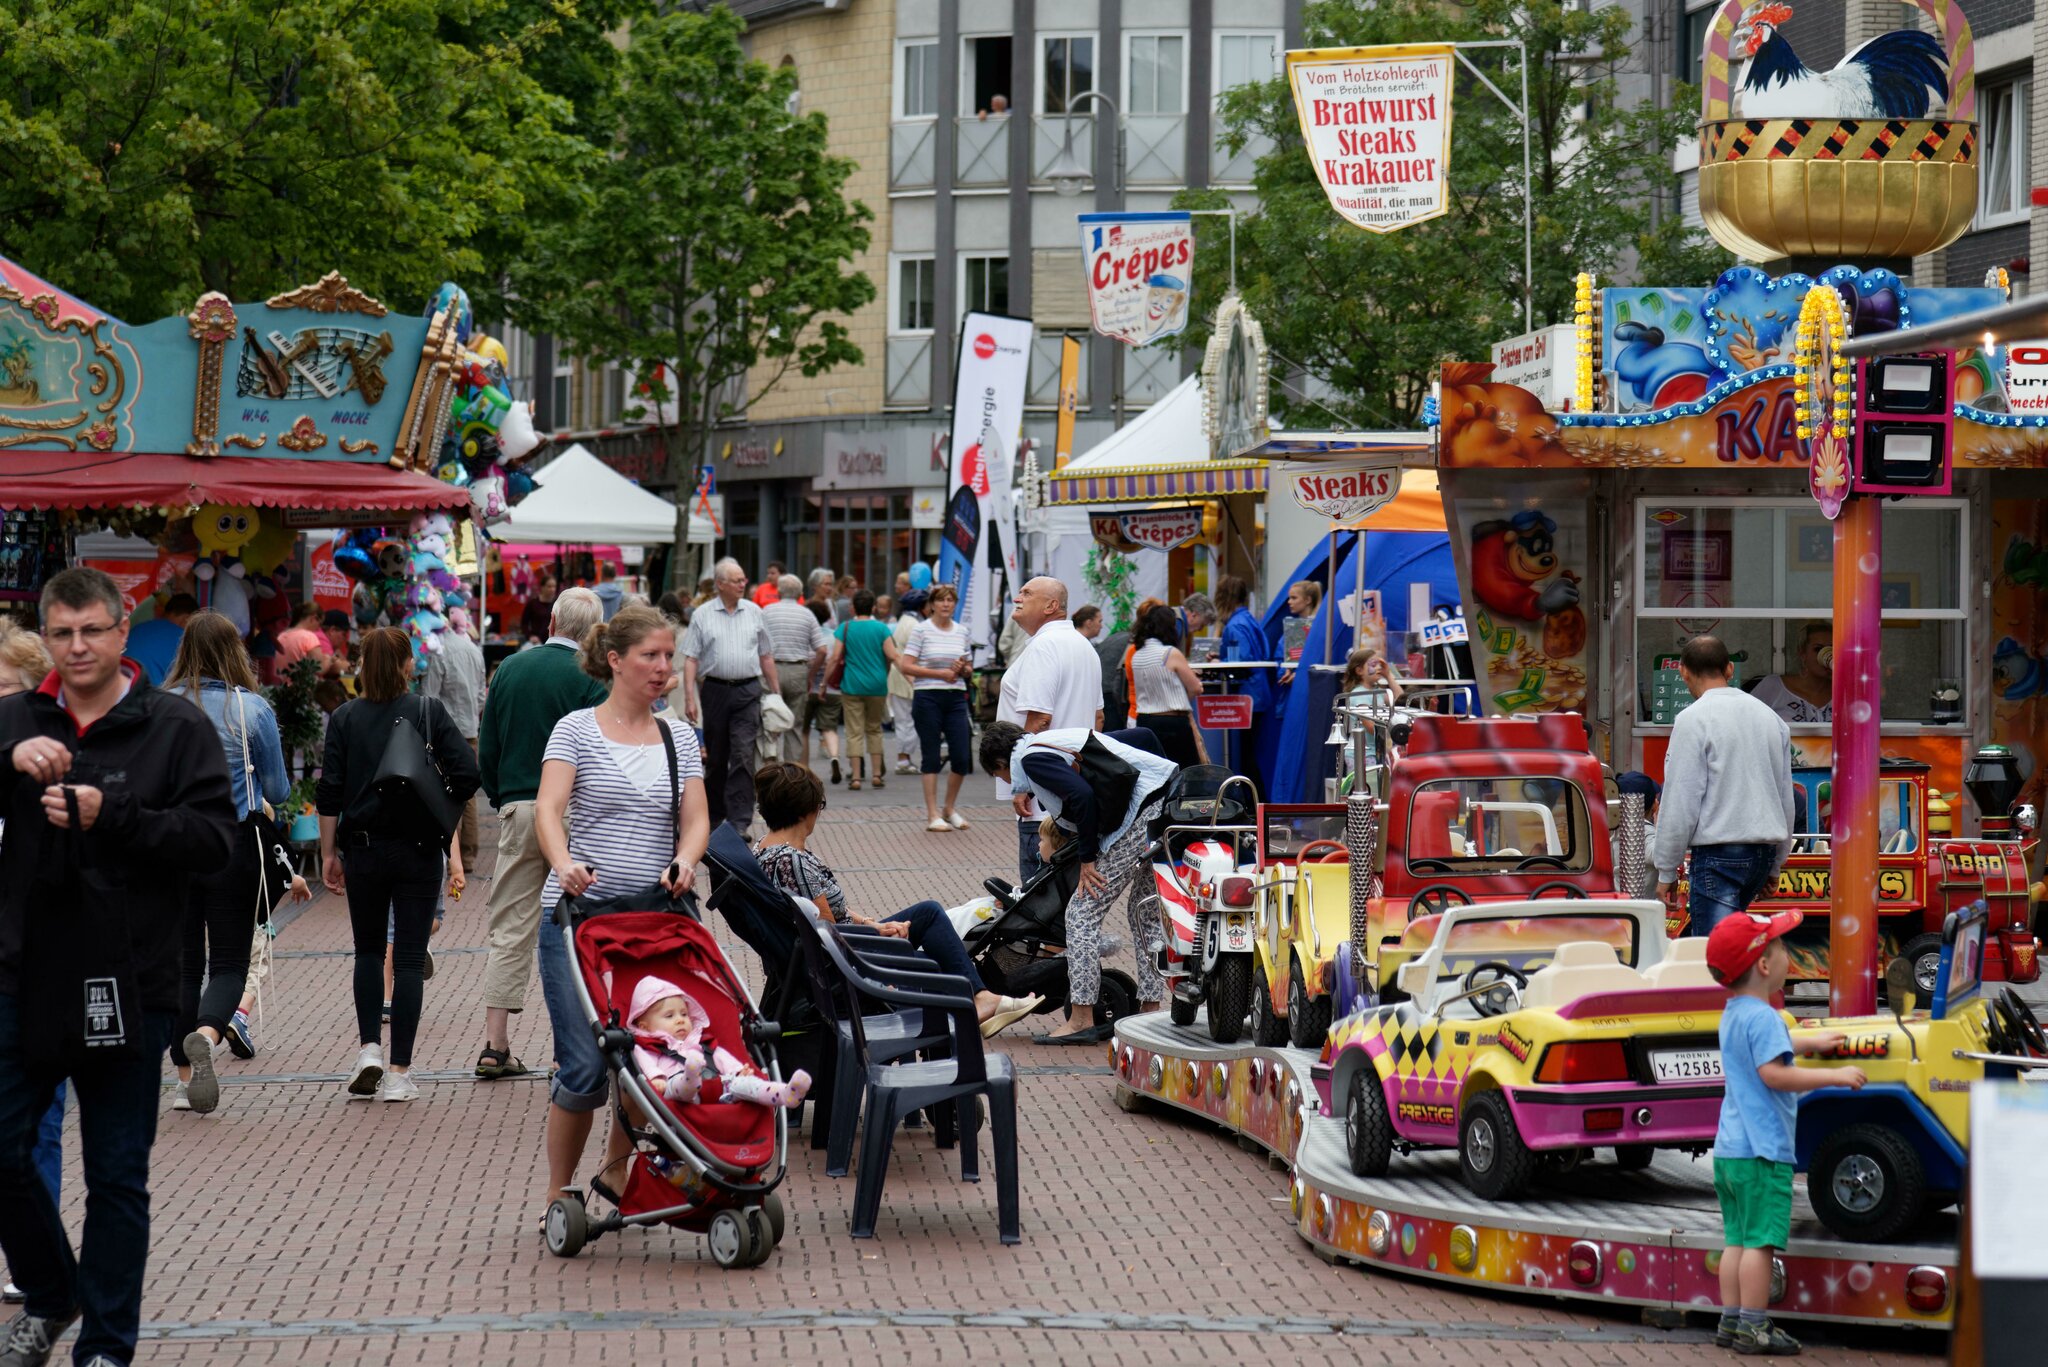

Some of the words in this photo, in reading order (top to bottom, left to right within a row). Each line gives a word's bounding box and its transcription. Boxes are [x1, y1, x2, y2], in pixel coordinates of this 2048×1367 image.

[1307, 71, 1337, 85] Vom
[1343, 63, 1438, 84] Holzkohlegrill
[1323, 88, 1335, 96] im
[1339, 84, 1384, 96] Brötchen
[1388, 82, 1428, 93] serviert:
[1313, 93, 1437, 127] Bratwurst
[1337, 127, 1416, 157] Steaks
[1323, 158, 1436, 186] Krakauer
[1336, 196, 1387, 210] Qualität,
[1389, 196, 1406, 208] die
[1409, 196, 1433, 207] man
[1357, 210, 1410, 222] schmeckt!
[1092, 238, 1189, 291] Crêpes
[331, 410, 371, 425] MOCKE
[1298, 472, 1389, 502] Steaks
[1128, 522, 1196, 547] Crêpes
[1659, 687, 1665, 695] 3
[1656, 700, 1664, 708] 4
[1655, 712, 1663, 721] 6
[1946, 853, 2003, 876] 1880
[1207, 920, 1218, 959] 5
[1675, 1052, 1711, 1060] PHOENIX
[1658, 1060, 1721, 1078] Y-12585
[1398, 1103, 1456, 1126] PRESTIGE
